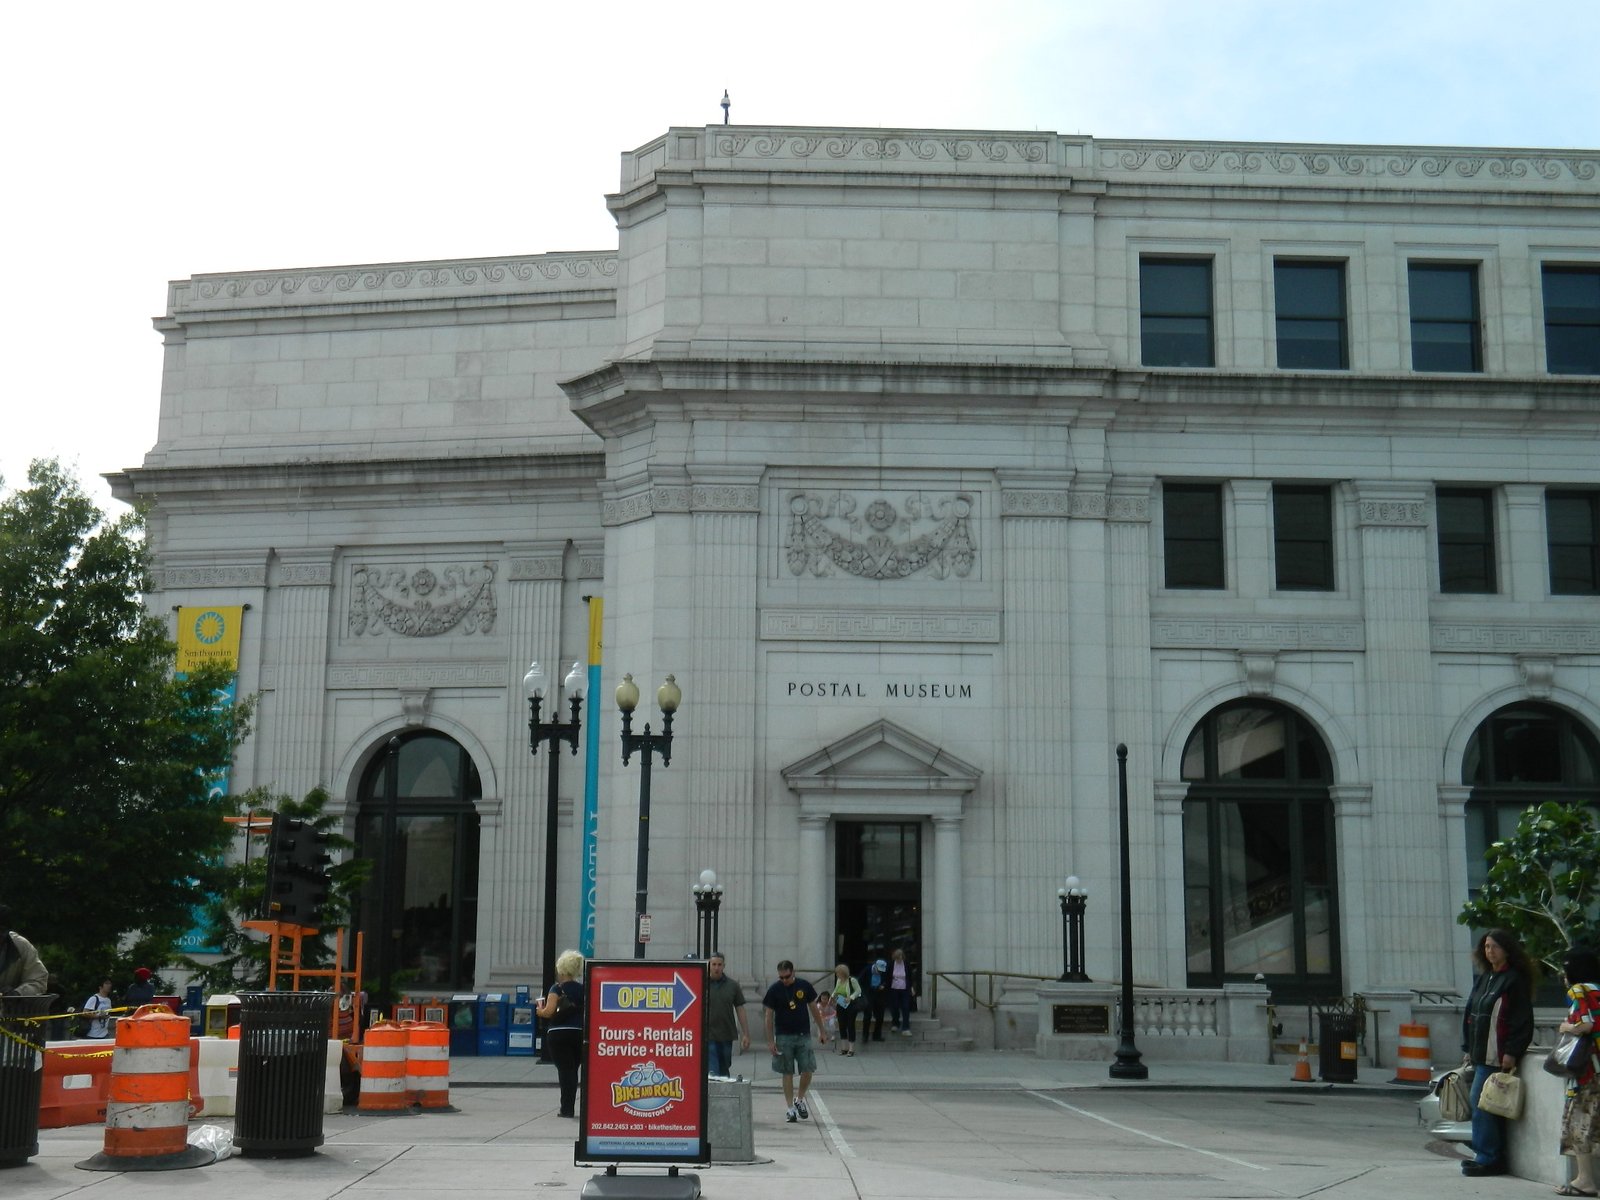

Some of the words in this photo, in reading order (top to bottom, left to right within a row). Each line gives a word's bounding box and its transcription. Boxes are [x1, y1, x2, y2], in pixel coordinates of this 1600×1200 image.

[184, 649, 232, 657] Smithsonian
[788, 682, 866, 697] POSTAL
[886, 683, 972, 698] MUSEUM
[617, 987, 673, 1008] OPEN
[599, 1026, 635, 1041] Tours
[643, 1027, 693, 1041] Rentals
[597, 1043, 647, 1057] Service
[655, 1043, 693, 1057] Retail
[614, 1085, 641, 1104] BIKE
[641, 1086, 653, 1097] AND
[653, 1080, 682, 1098] ROLL
[623, 1106, 666, 1118] WASHINGTON
[665, 1103, 674, 1112] DC
